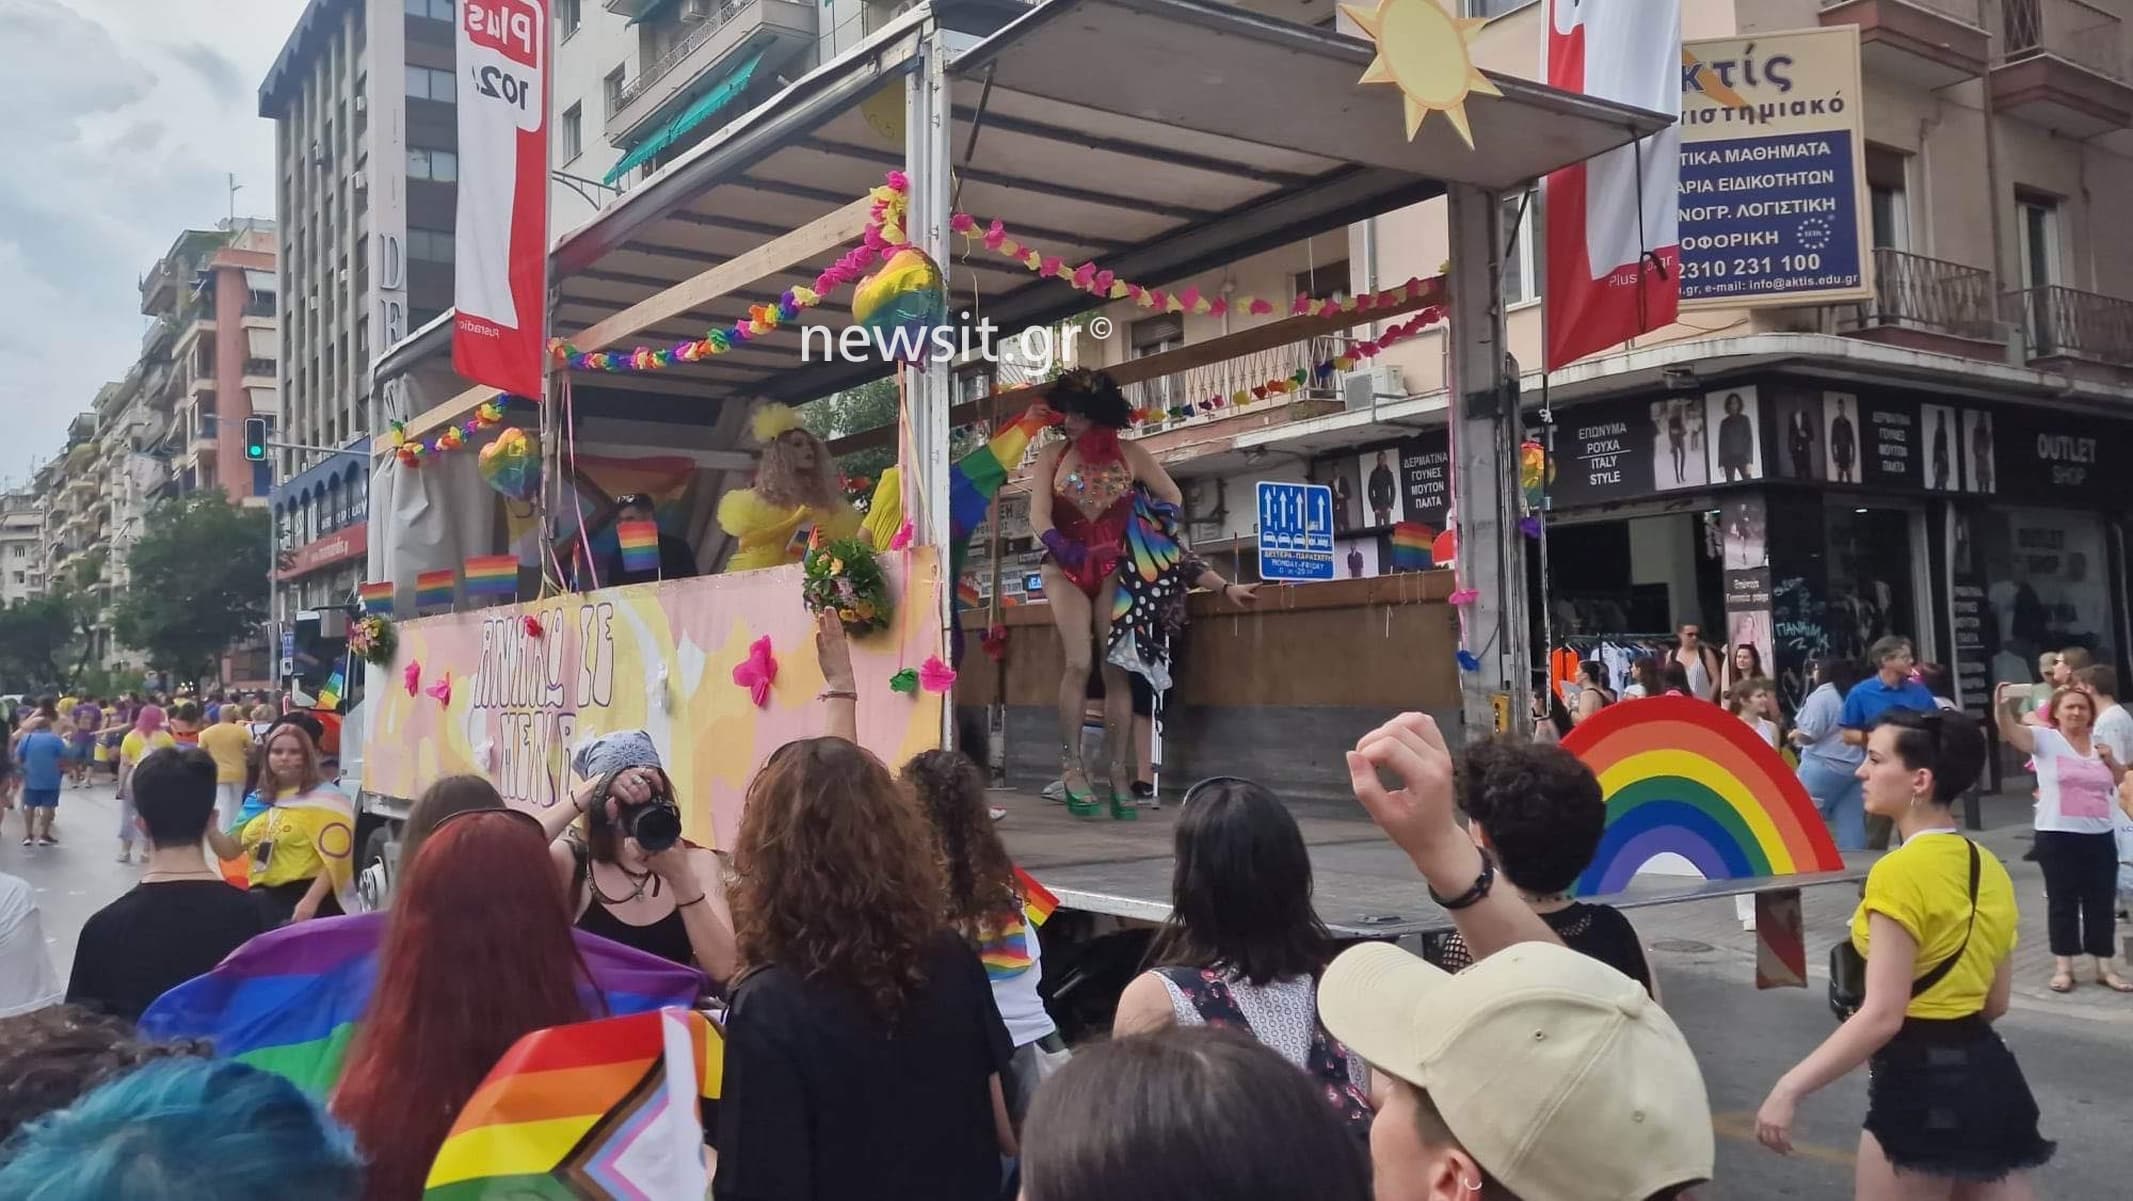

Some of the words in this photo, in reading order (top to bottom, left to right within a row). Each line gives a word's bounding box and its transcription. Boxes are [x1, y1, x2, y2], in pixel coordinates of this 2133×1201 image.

[1725, 141, 1831, 164] ΜΑΘΗΜΑΤΑ
[1718, 169, 1834, 192] ΕΙΔΙΚΟΤΗΤΩΝ
[1736, 197, 1836, 219] ΛΟΓΙΣΤΙΚΗ
[1733, 256, 1771, 275] 231
[1780, 253, 1821, 271] 100
[1704, 280, 1747, 294] e-mail:
[1749, 272, 1858, 291] info@aktis.edu.gr
[1578, 421, 1628, 440] ΕΠΩΝΥΜΑ
[1586, 439, 1621, 454] ΡΟΥΧΑ
[2037, 433, 2096, 463] OUTLET
[1591, 455, 1618, 470] ITALY
[1411, 467, 1442, 481] ΓΟΥΝΕΣ
[1589, 470, 1622, 486] STYLE
[2051, 464, 2086, 486] SHOP
[1411, 481, 1444, 496] ΜΟΥΤΟΝ
[1415, 496, 1442, 509] ΠΑΛΤΑ
